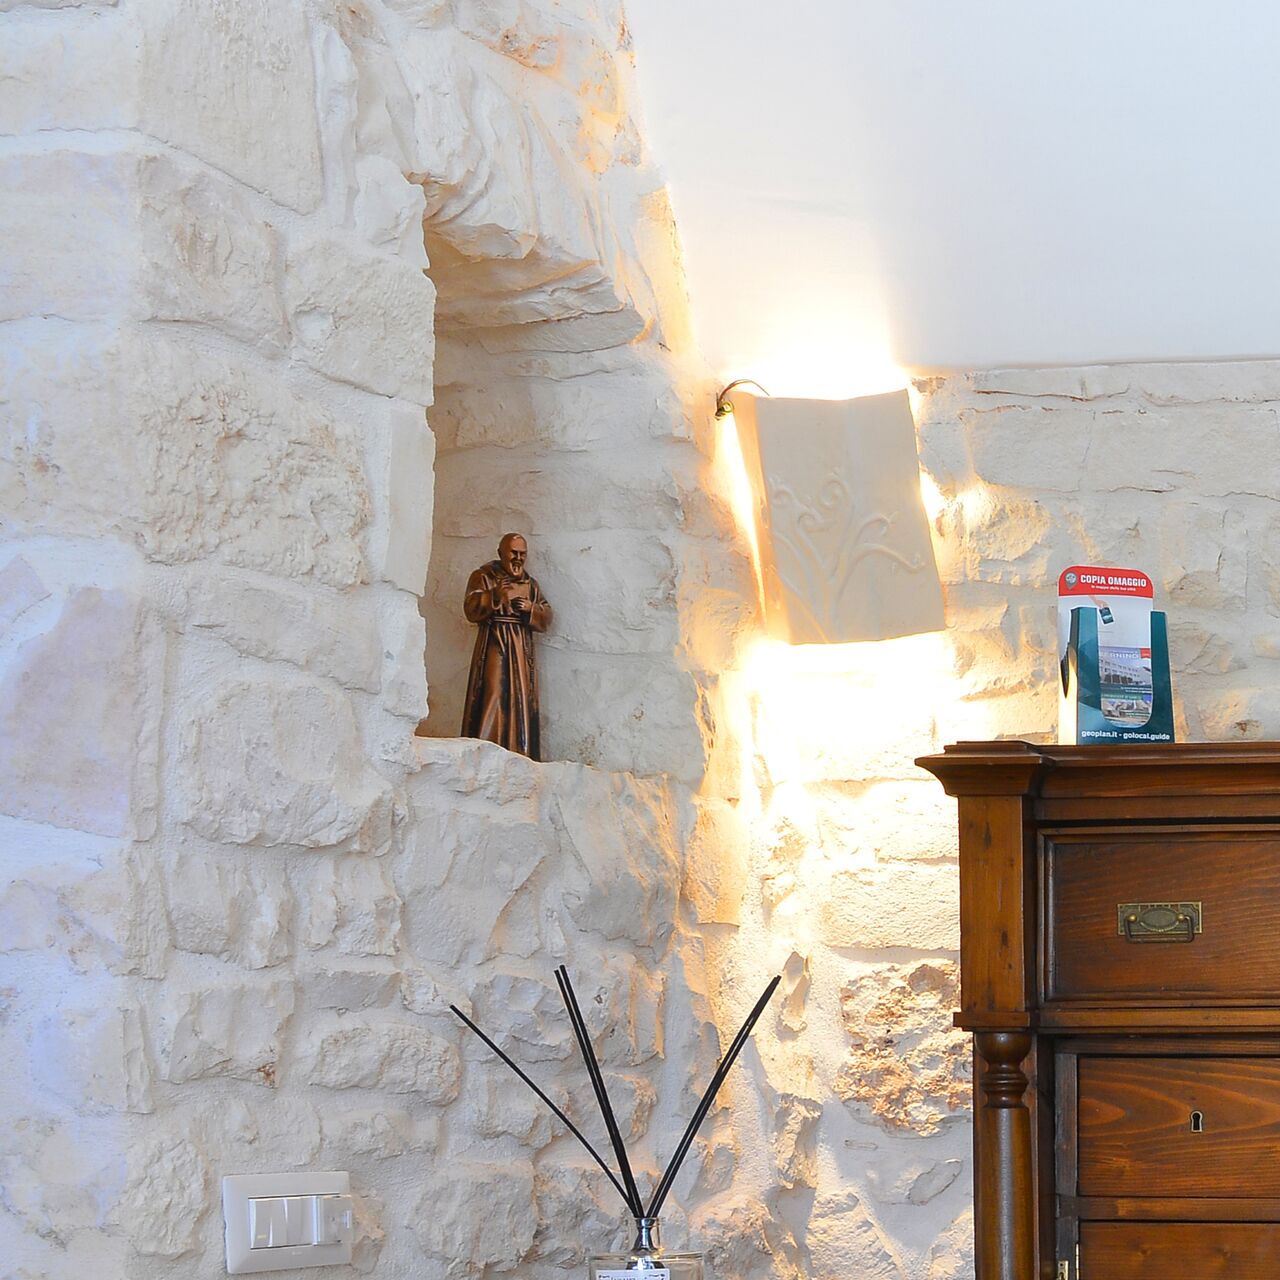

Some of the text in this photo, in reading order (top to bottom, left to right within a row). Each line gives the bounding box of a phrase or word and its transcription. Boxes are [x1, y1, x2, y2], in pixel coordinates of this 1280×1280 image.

[1080, 574, 1147, 587] COPIA OMAGGIO
[1081, 730, 1118, 738] geoplan.it
[1123, 731, 1170, 741] golocal.guide
